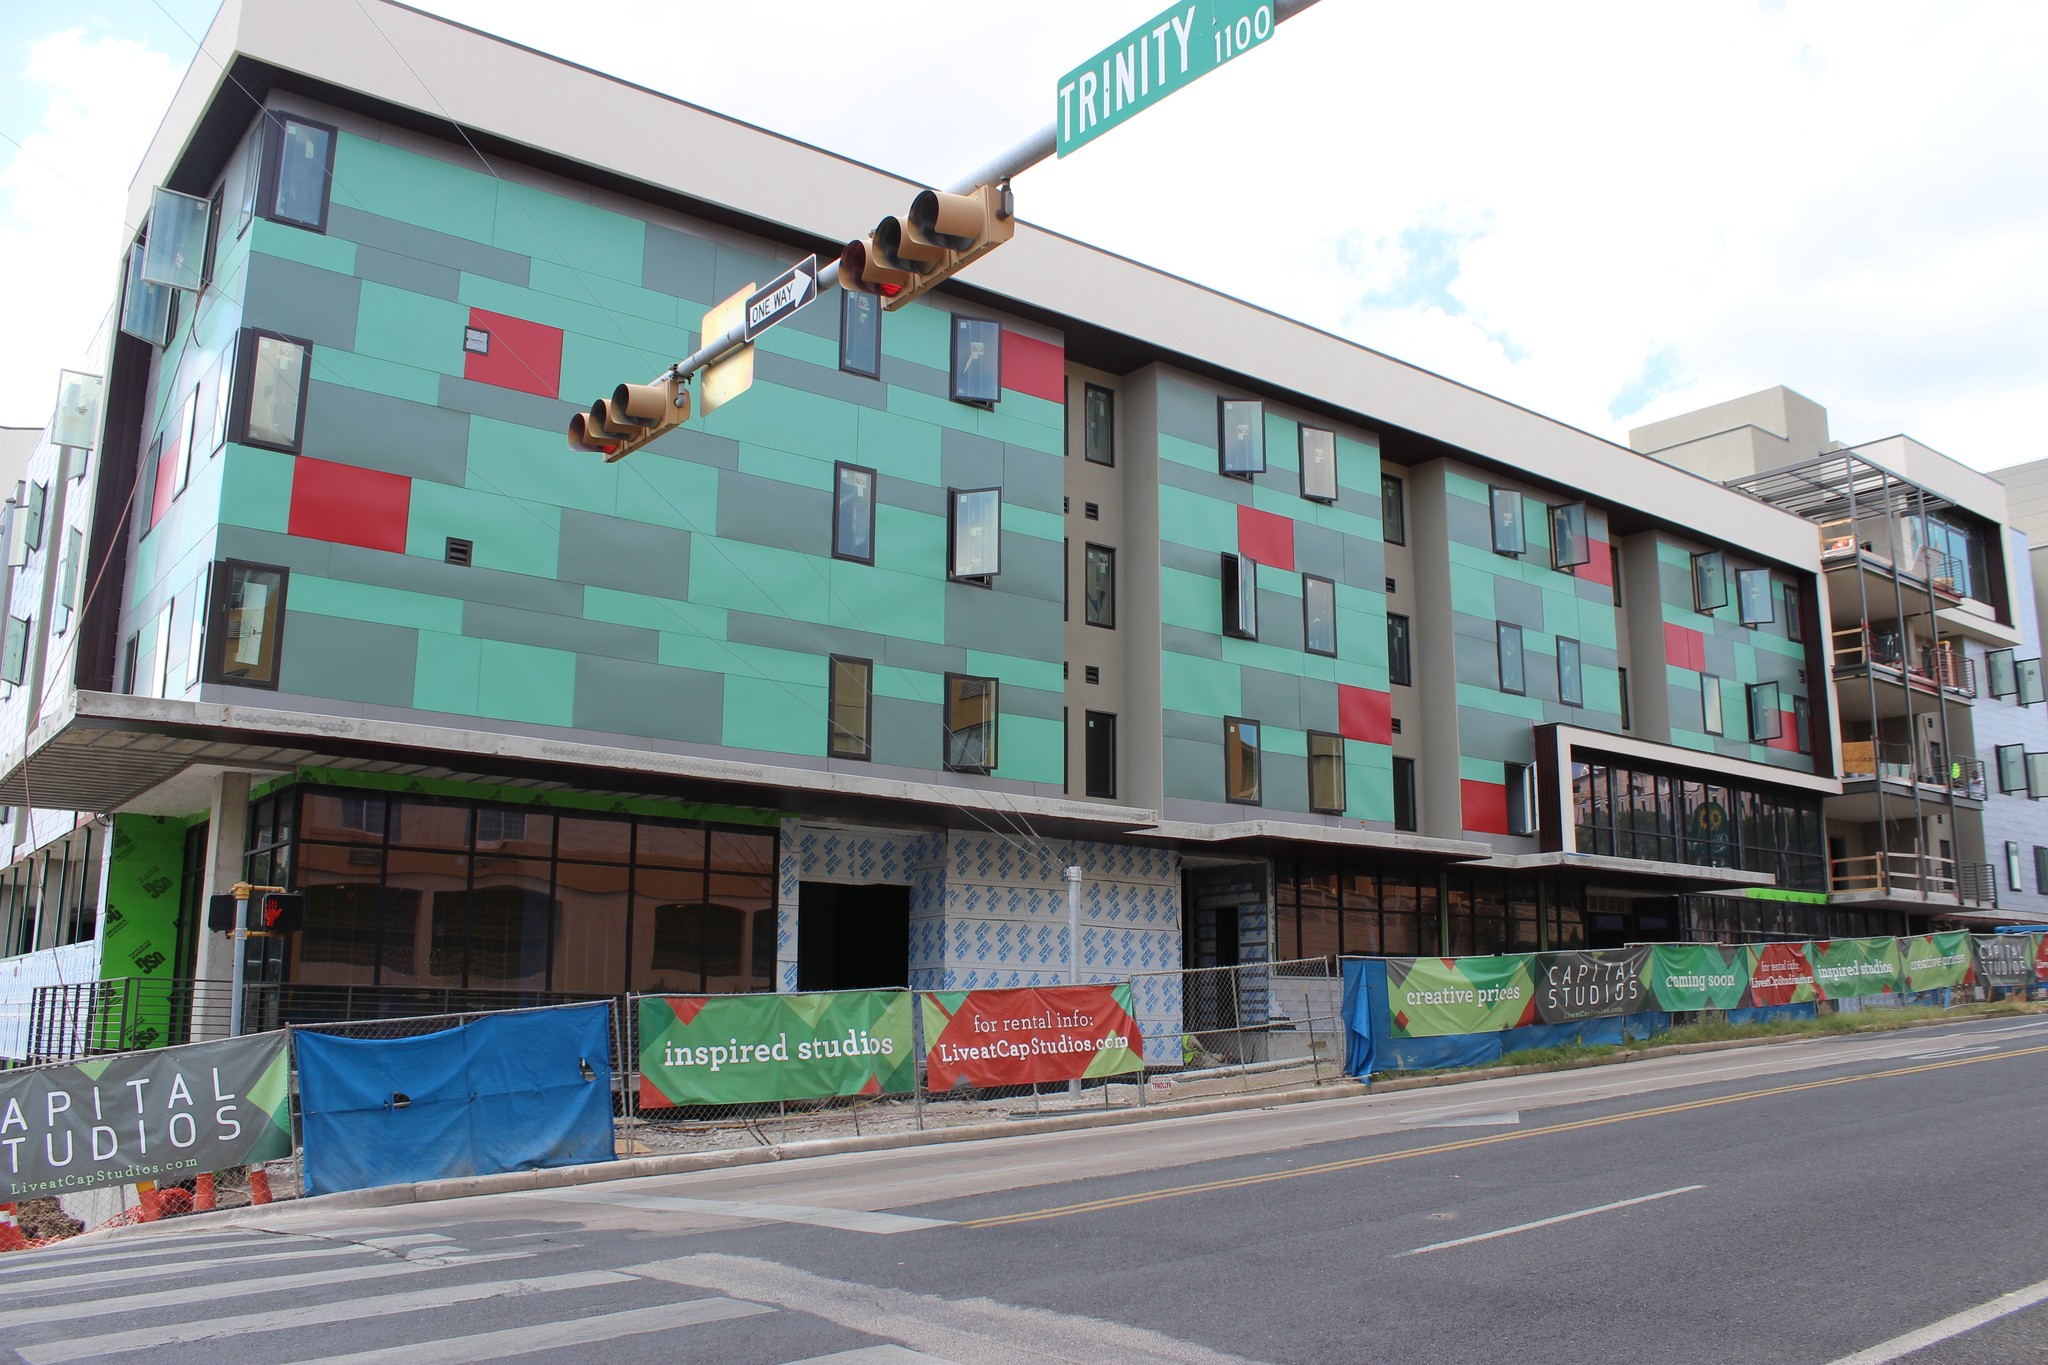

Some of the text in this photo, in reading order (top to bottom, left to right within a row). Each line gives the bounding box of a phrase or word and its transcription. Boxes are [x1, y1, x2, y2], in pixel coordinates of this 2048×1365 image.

[1059, 4, 1271, 144] TRINITY 1100
[752, 282, 794, 323] ONE WAY
[1911, 956, 1942, 970] creative
[1980, 944, 2024, 959] CAPITAL
[1549, 961, 1637, 986] CAPITAL
[1666, 971, 1735, 992] coming soon
[1818, 959, 1894, 981] inspired studios
[1980, 961, 2027, 975] STUDIOS
[1406, 983, 1521, 1008] creative prices
[1548, 980, 1637, 1009] STUDIOS
[973, 1009, 1094, 1033] for rental info:
[664, 1028, 894, 1072] inspired studios
[939, 1033, 1129, 1063] LiveatCapStudios.com
[1, 1067, 236, 1135] APITAL
[2, 1105, 242, 1174] TUDIOS
[11, 1157, 199, 1195] LiveatCapStudios.com
